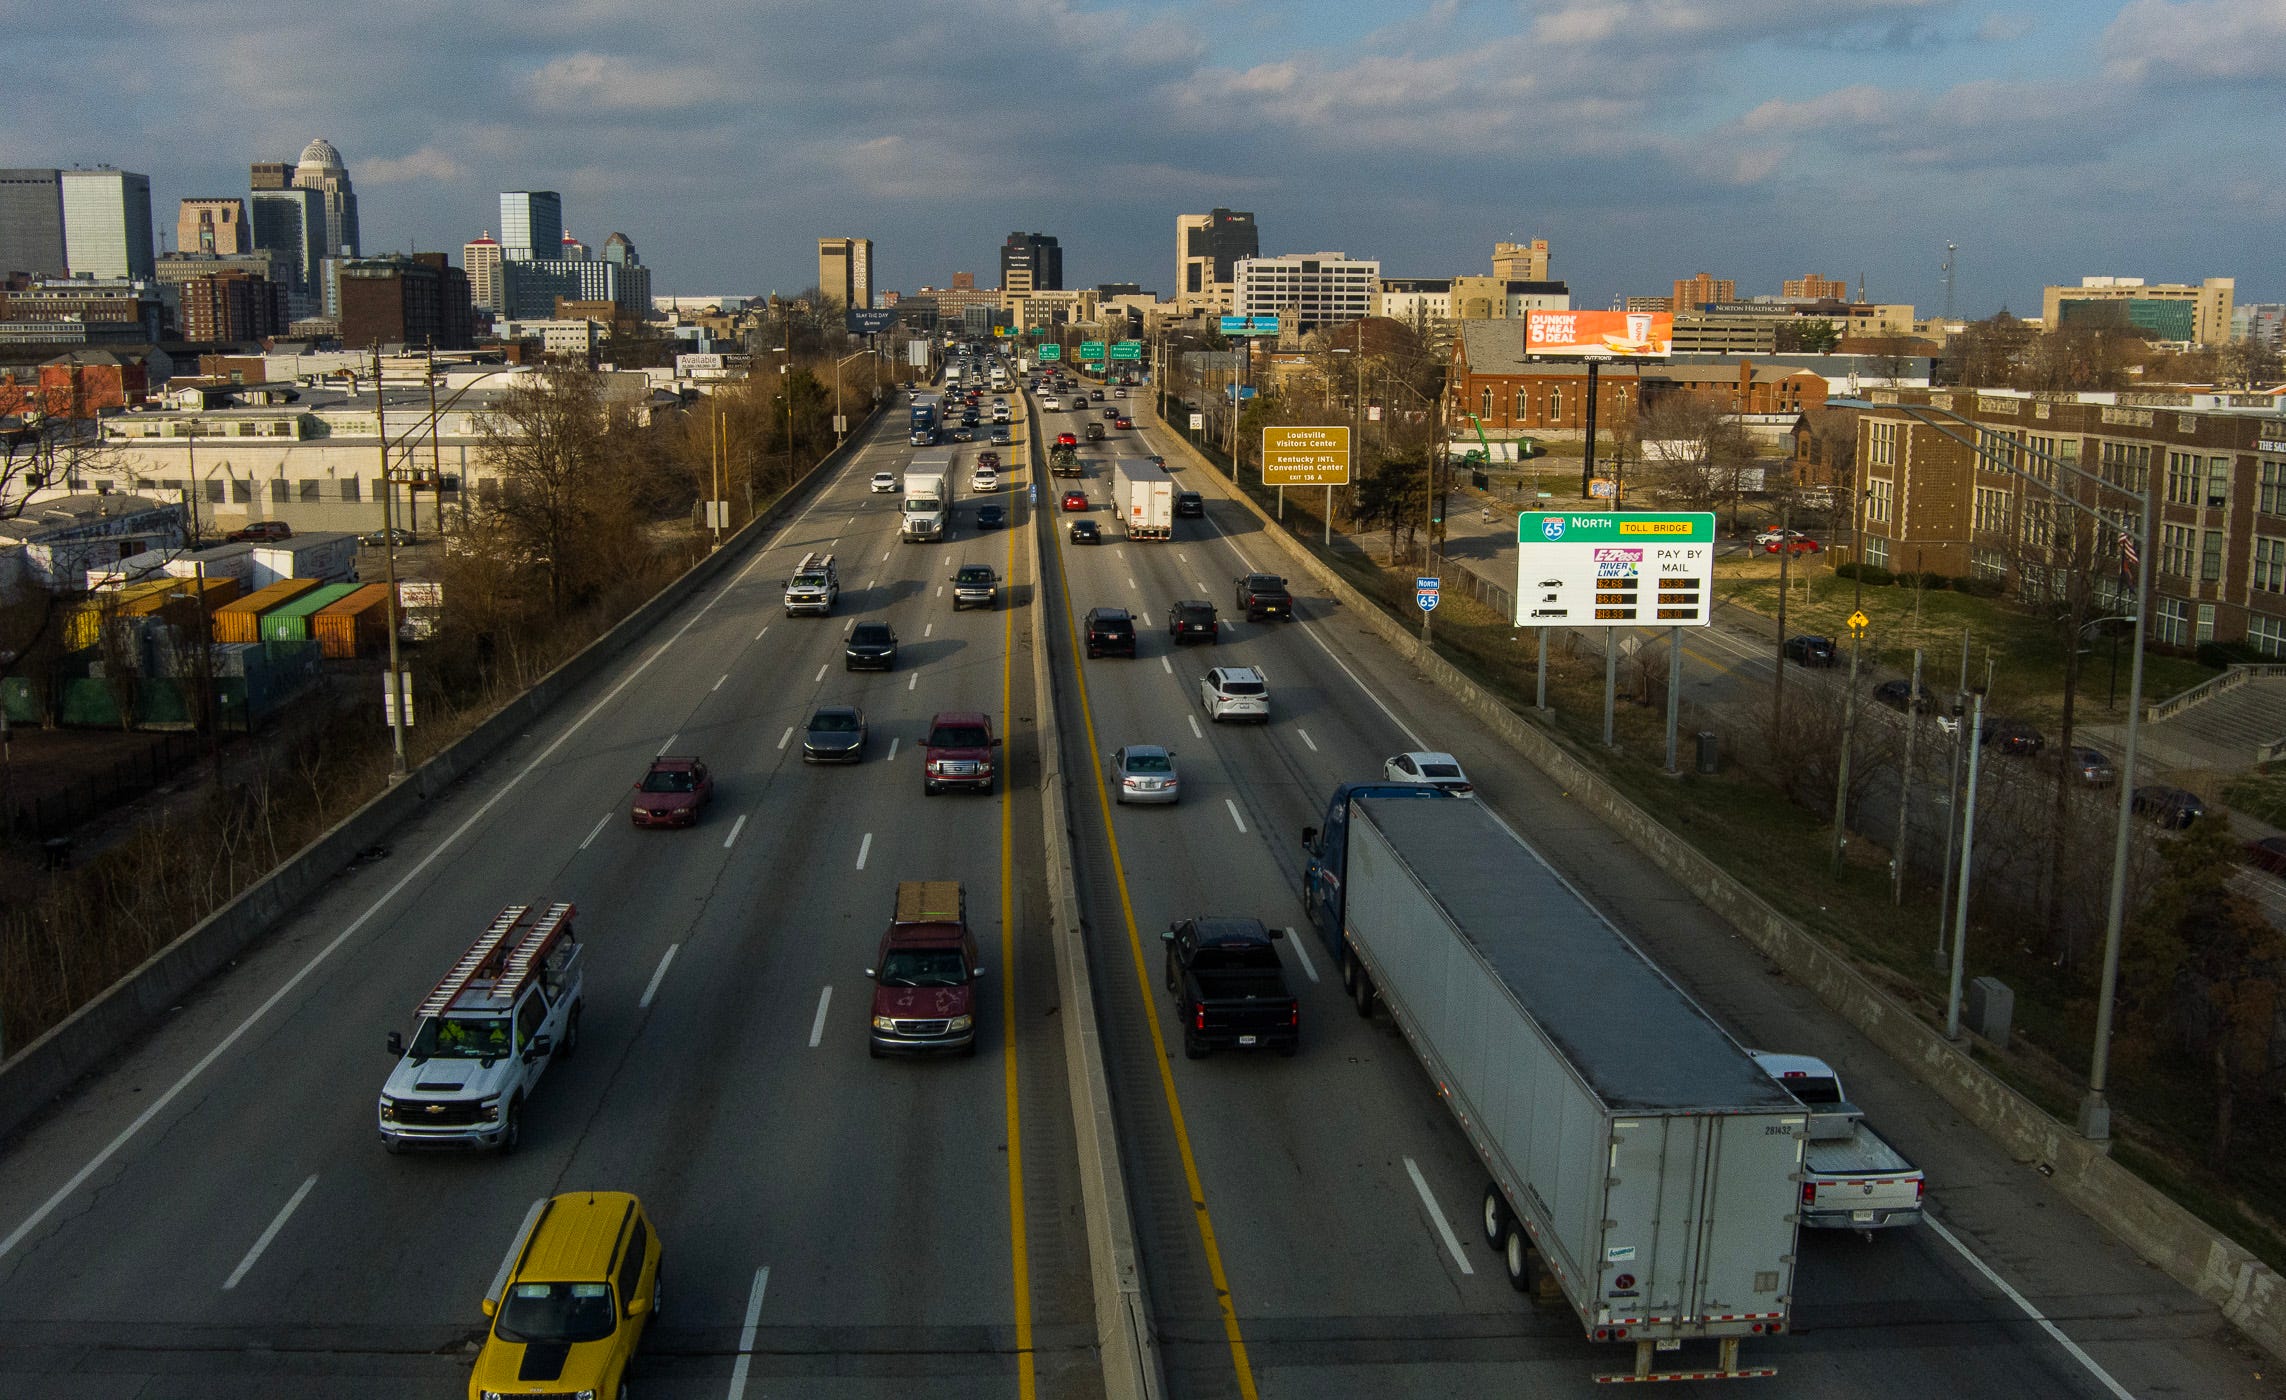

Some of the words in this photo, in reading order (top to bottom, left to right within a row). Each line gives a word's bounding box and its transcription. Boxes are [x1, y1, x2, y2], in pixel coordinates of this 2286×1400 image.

[859, 243, 867, 289] JEFFERSON
[1716, 304, 1744, 312] NORTON
[1744, 304, 1786, 312] HEALTHCARE
[1531, 314, 1577, 325] DUNKIN'
[1546, 325, 1576, 334] MEAL
[1545, 333, 1576, 343] DEAL
[682, 355, 716, 364] Available
[2258, 440, 2273, 451] THE
[1277, 456, 1314, 464] Kentucky
[1545, 523, 1563, 537] 65
[1571, 517, 1612, 529] NORTH
[1625, 524, 1648, 532] TOLL
[1653, 524, 1688, 532] BRIDGE
[1657, 550, 1681, 559] PAY
[1687, 550, 1703, 559] BY
[1599, 562, 1628, 570] RIVER
[1661, 563, 1689, 573] MAIL
[1597, 569, 1620, 577] LINK
[1418, 579, 1438, 588] NORTH
[1420, 595, 1436, 607] 65
[1765, 1125, 1792, 1136] 281432
